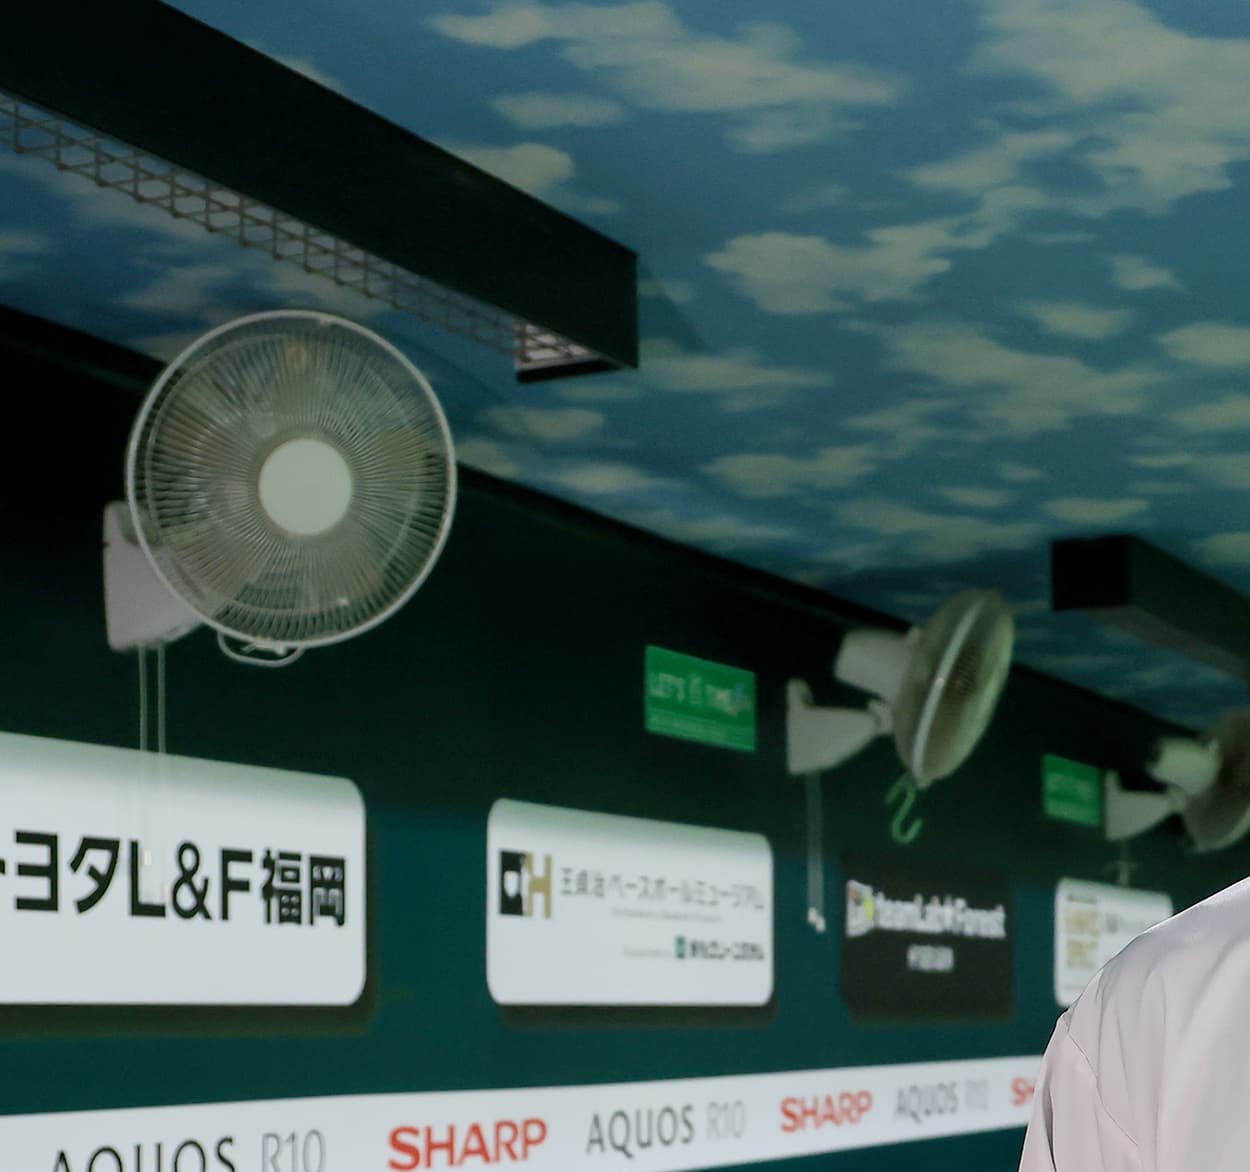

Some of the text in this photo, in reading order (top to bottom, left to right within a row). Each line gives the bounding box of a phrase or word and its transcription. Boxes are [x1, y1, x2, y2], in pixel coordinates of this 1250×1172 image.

[0, 829, 347, 928] ヨタL&F福岡
[387, 1117, 549, 1172] SHARP
[585, 1104, 696, 1159] AQUOS
[705, 1100, 748, 1140] R10
[780, 1089, 875, 1134] SHARP
[894, 1081, 959, 1124] AQUOS
